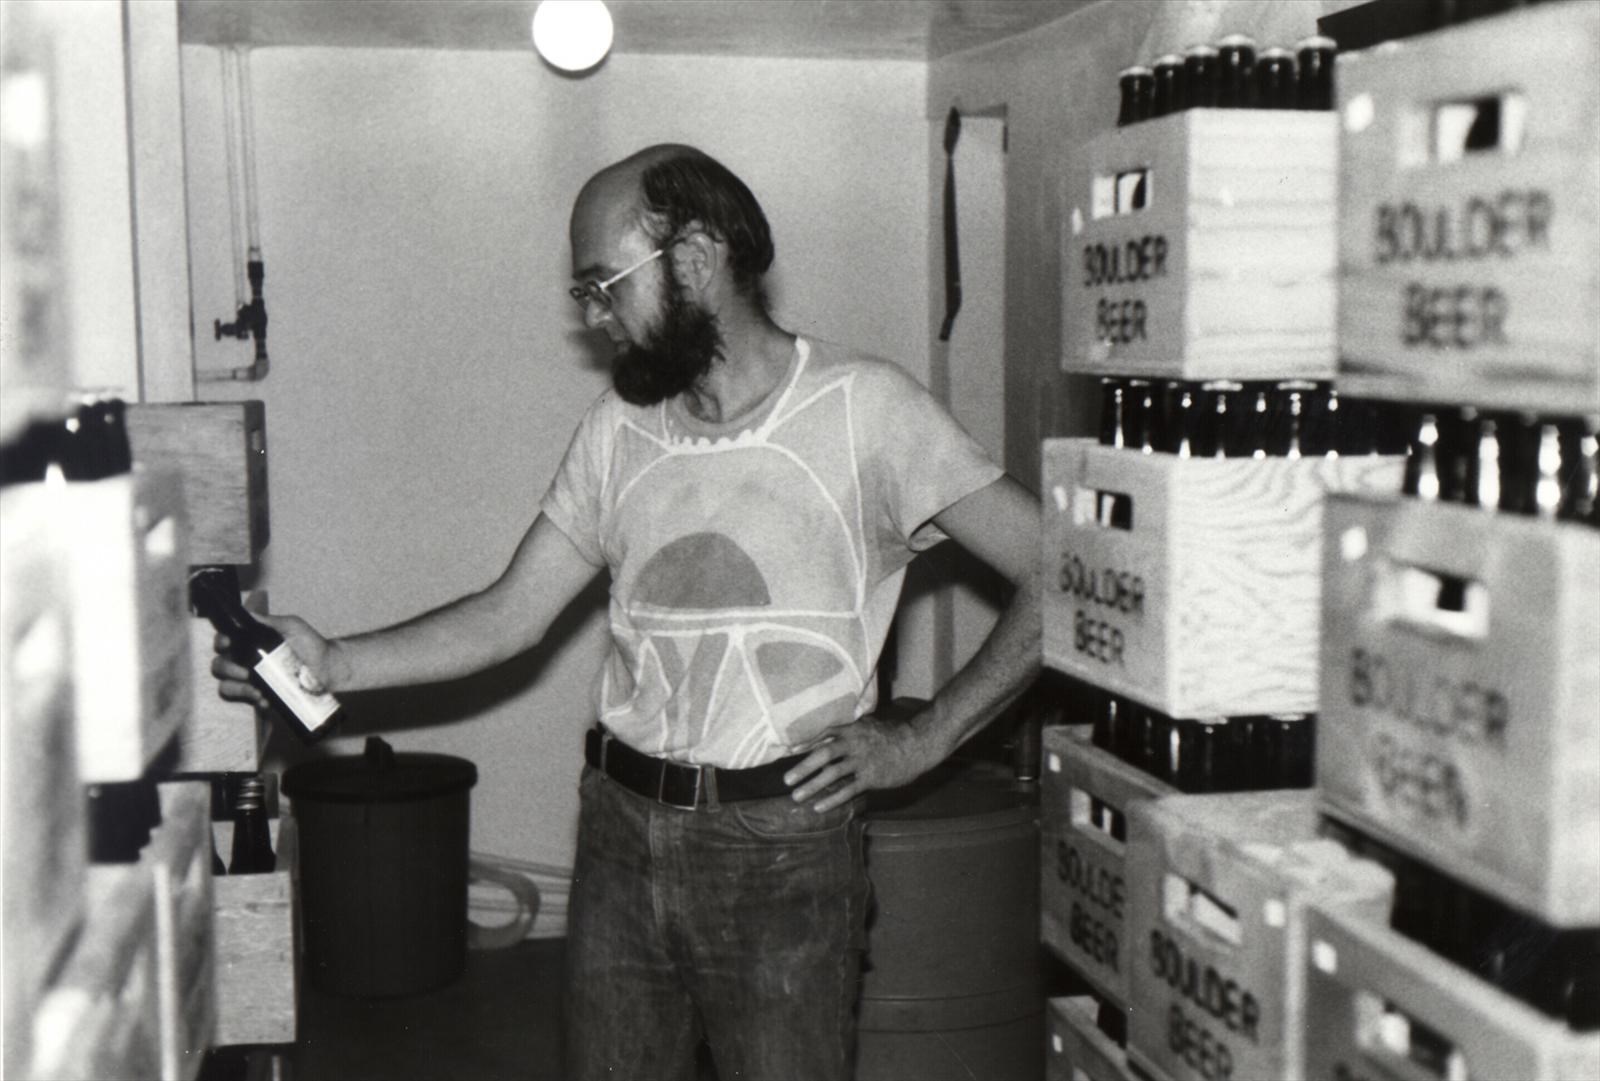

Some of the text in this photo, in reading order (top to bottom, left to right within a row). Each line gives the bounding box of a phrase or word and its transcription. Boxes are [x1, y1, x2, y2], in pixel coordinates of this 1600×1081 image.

[1083, 235, 1168, 288] BOULDER
[1374, 188, 1554, 267] BOULDER
[1097, 298, 1147, 344] BEER
[1402, 284, 1509, 348] BEER
[1059, 552, 1144, 620] BOULDER
[1074, 611, 1126, 668] BEER
[1057, 839, 1125, 920] BOULDE
[1069, 902, 1120, 975] BEER
[1151, 929, 1260, 1044] BOULDER
[1167, 1003, 1234, 1081] BEER
